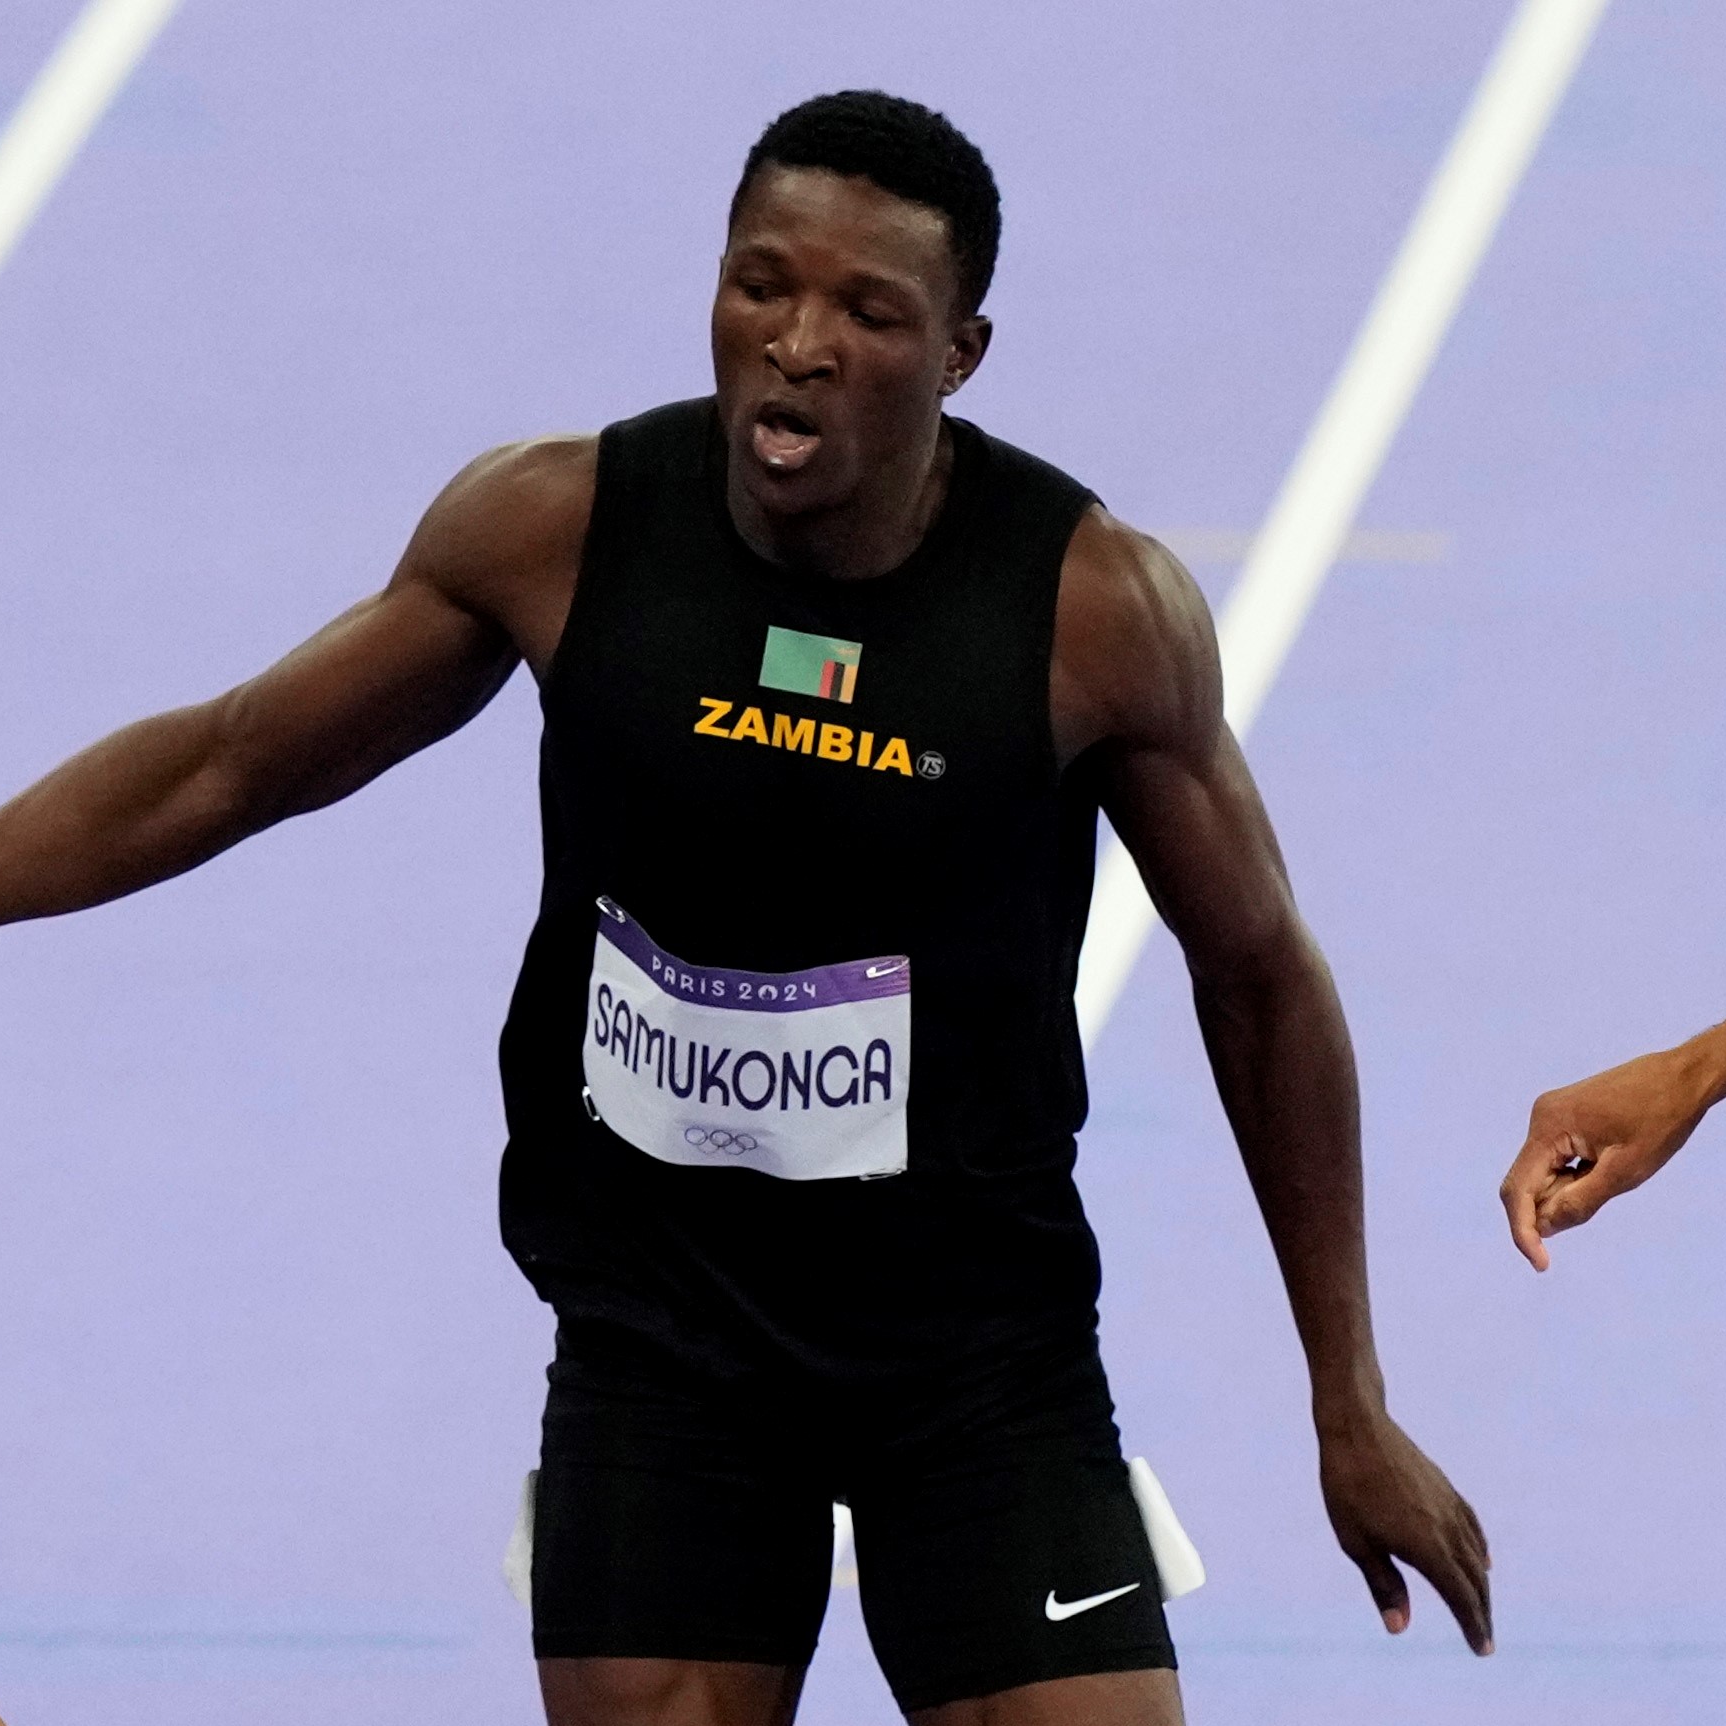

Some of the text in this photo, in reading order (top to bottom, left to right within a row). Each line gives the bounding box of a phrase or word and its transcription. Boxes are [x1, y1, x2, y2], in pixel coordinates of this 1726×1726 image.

[694, 697, 914, 777] ZAMBIA
[652, 954, 817, 1002] PARIS 2024
[594, 982, 892, 1112] SAMUKONGA
